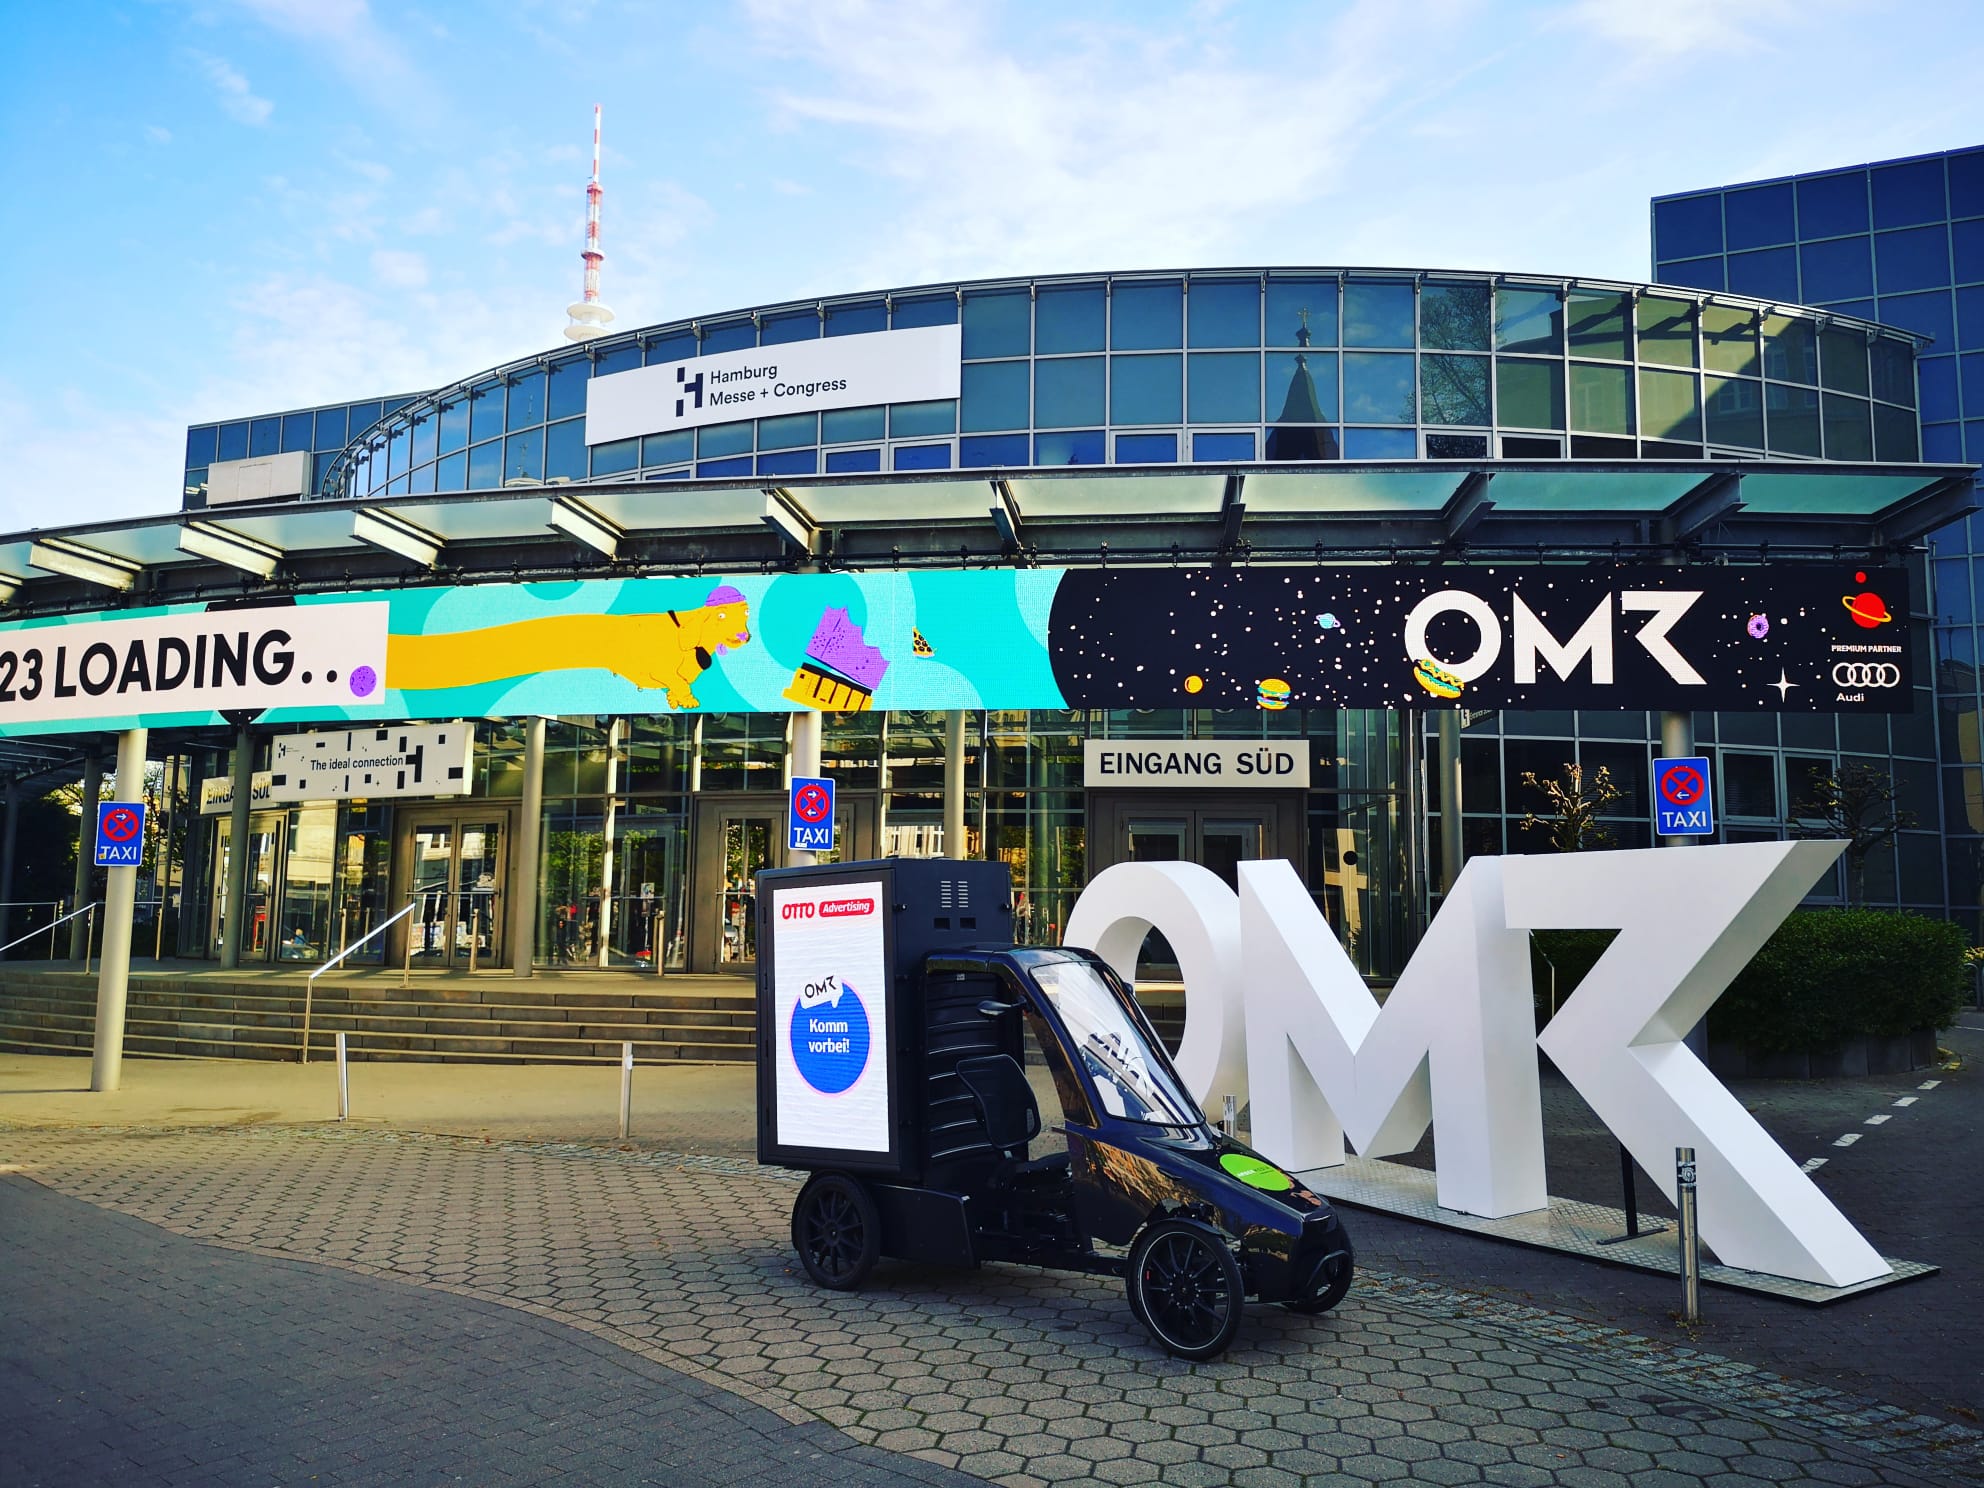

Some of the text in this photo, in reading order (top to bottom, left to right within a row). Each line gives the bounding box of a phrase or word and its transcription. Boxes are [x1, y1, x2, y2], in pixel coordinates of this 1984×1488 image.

[710, 365, 778, 385] Hamburg
[710, 379, 847, 406] Messe + Congress
[1404, 589, 1708, 685] OMR
[1831, 644, 1902, 653] PREMIUM PARTNER
[1836, 692, 1865, 702] Audi
[311, 754, 404, 771] The ideal connection
[1100, 747, 1294, 775] EINGANG SÜD
[1661, 811, 1707, 828] TAXI
[793, 827, 829, 844] TAXI
[100, 846, 137, 860] TAXI
[782, 901, 870, 919] OTTO Advertising
[804, 975, 837, 999] OMR
[809, 1018, 849, 1033] Komm
[808, 1037, 850, 1053] vorbei!
[1064, 839, 1894, 1288] OMR
